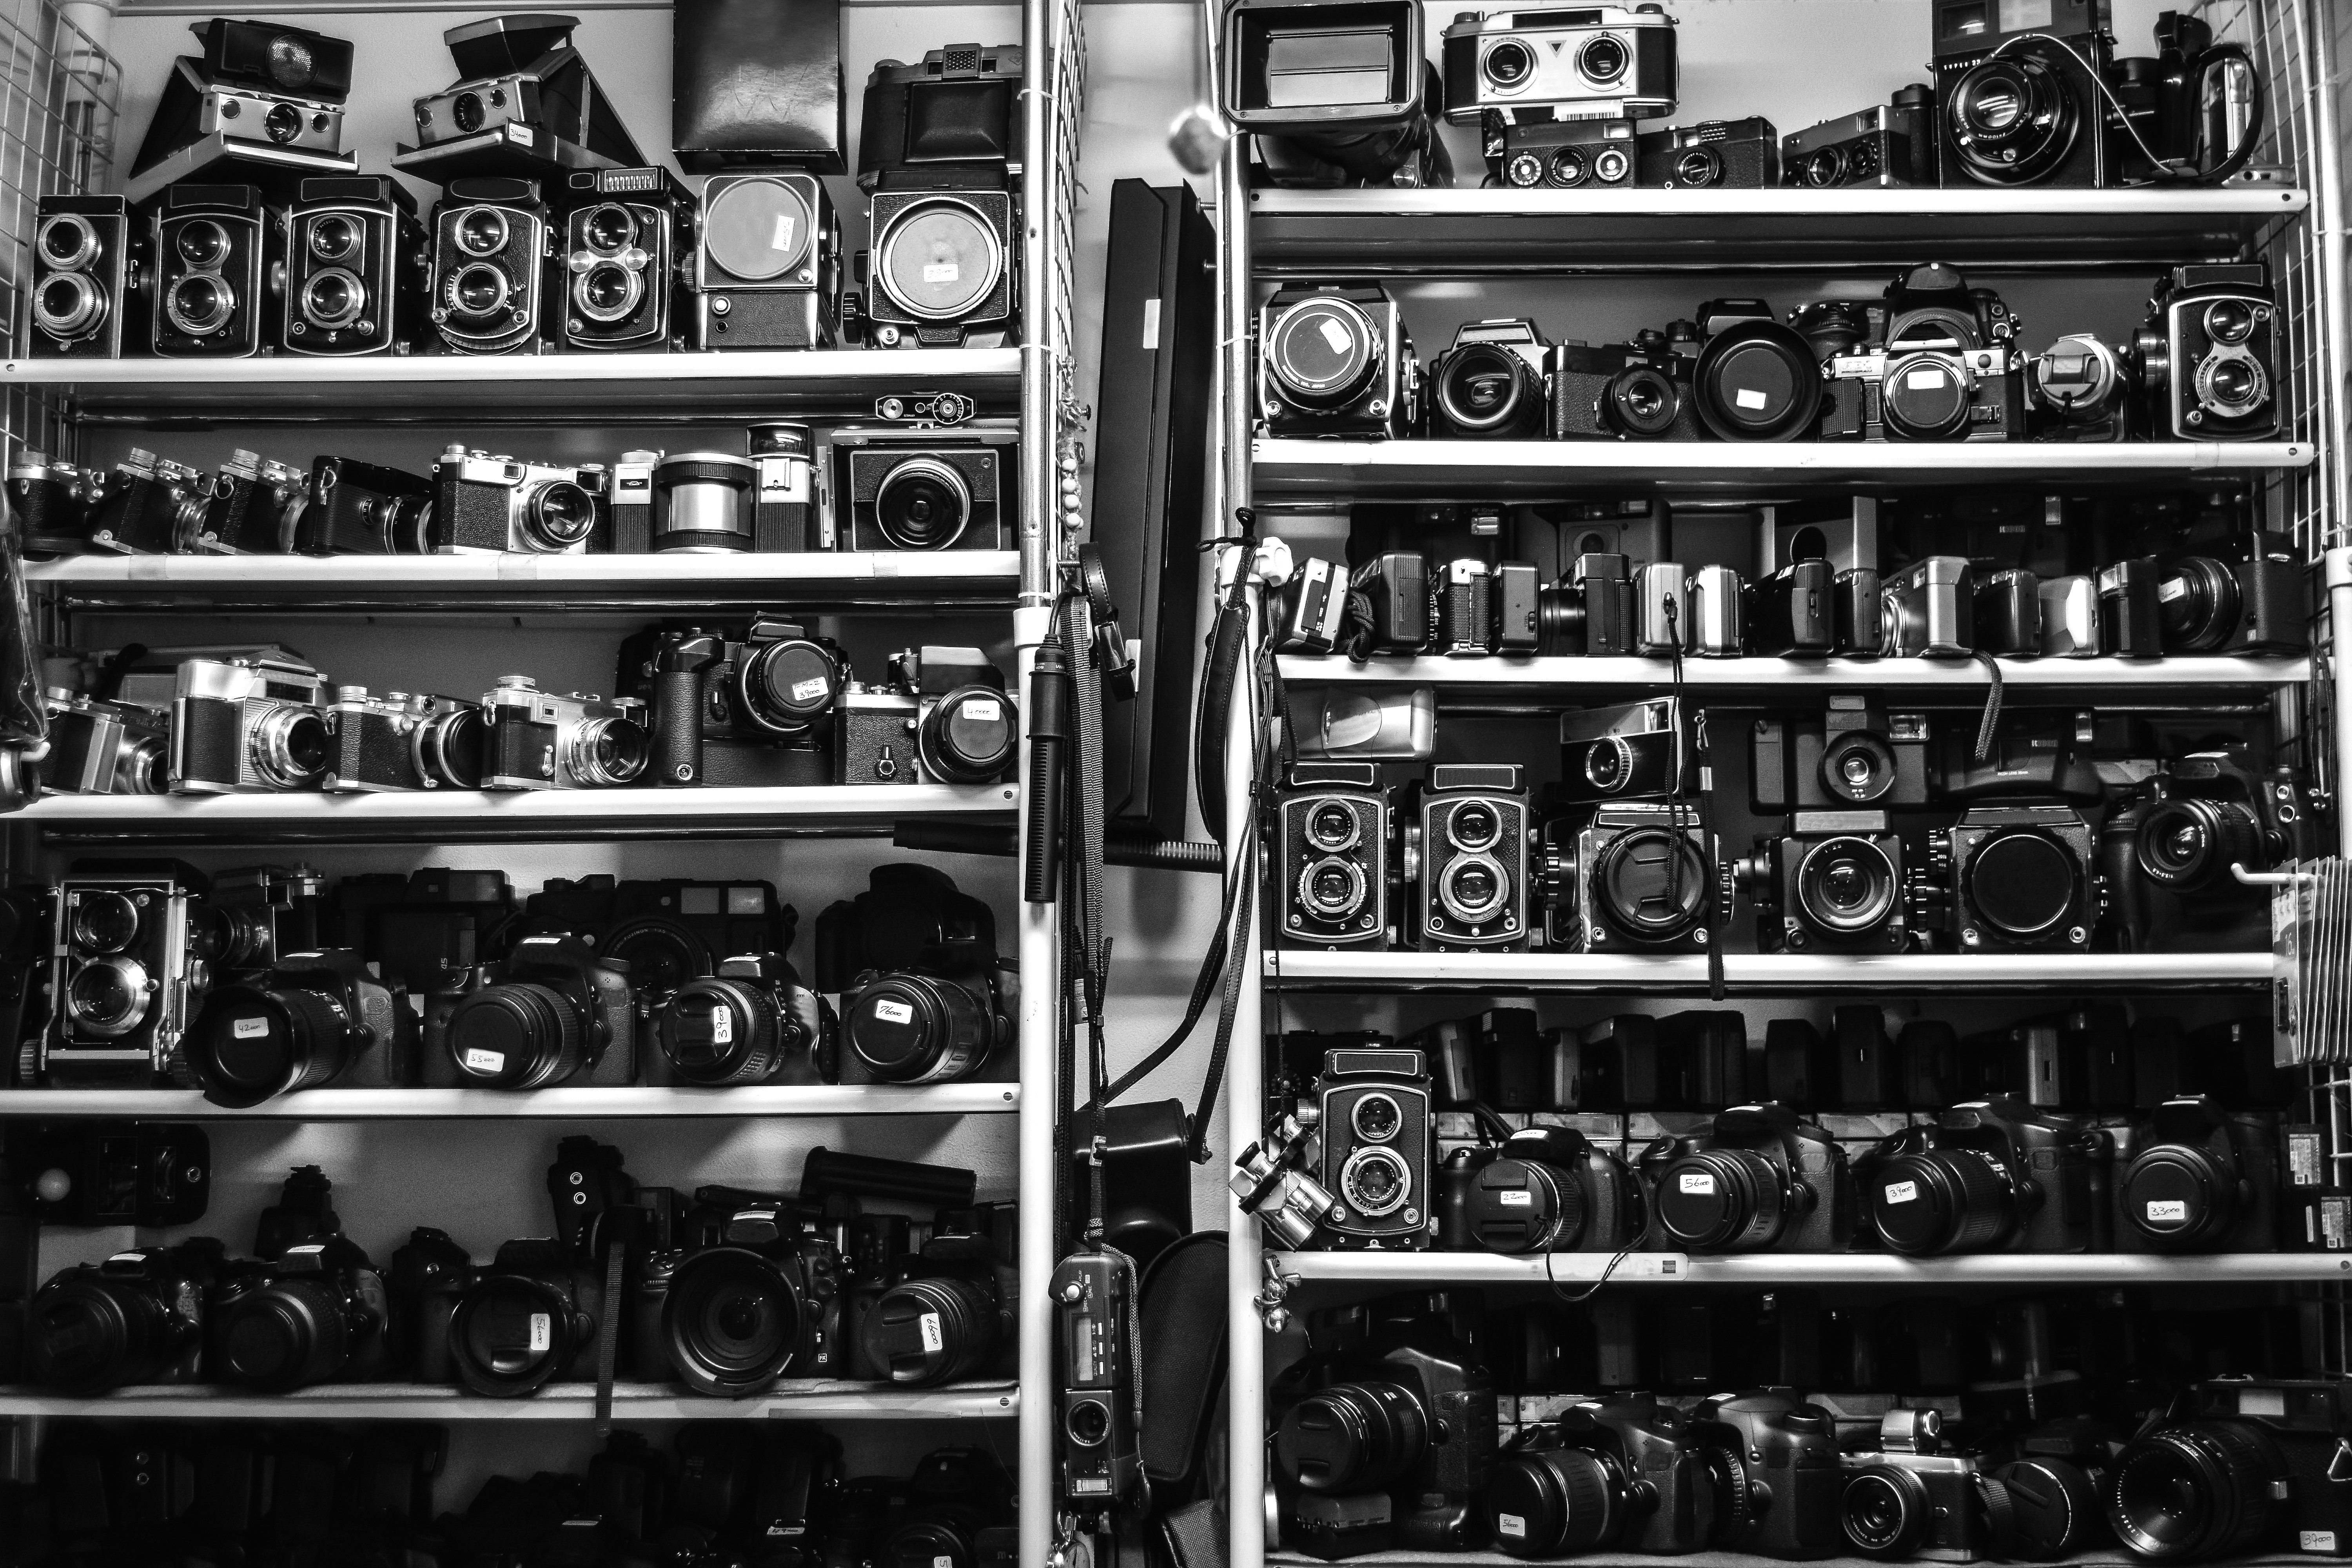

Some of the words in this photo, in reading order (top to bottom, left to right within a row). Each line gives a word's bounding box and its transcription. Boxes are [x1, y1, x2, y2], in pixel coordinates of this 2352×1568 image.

[510, 129, 528, 139] 34000
[799, 690, 820, 699] 39000
[624, 928, 648, 940] FUJINON
[879, 1005, 902, 1016] 76000
[239, 1024, 261, 1033] 42000
[716, 1007, 727, 1039] 39000
[470, 1054, 495, 1062] 55000
[1684, 1178, 1710, 1189] 56000
[1889, 1186, 1913, 1198] 39000
[2151, 1207, 2180, 1216] 33000
[537, 1317, 545, 1344] 56000
[927, 1318, 938, 1345] 66000
[1503, 1519, 1519, 1528] 56000
[2304, 1533, 2331, 1549] 39000
